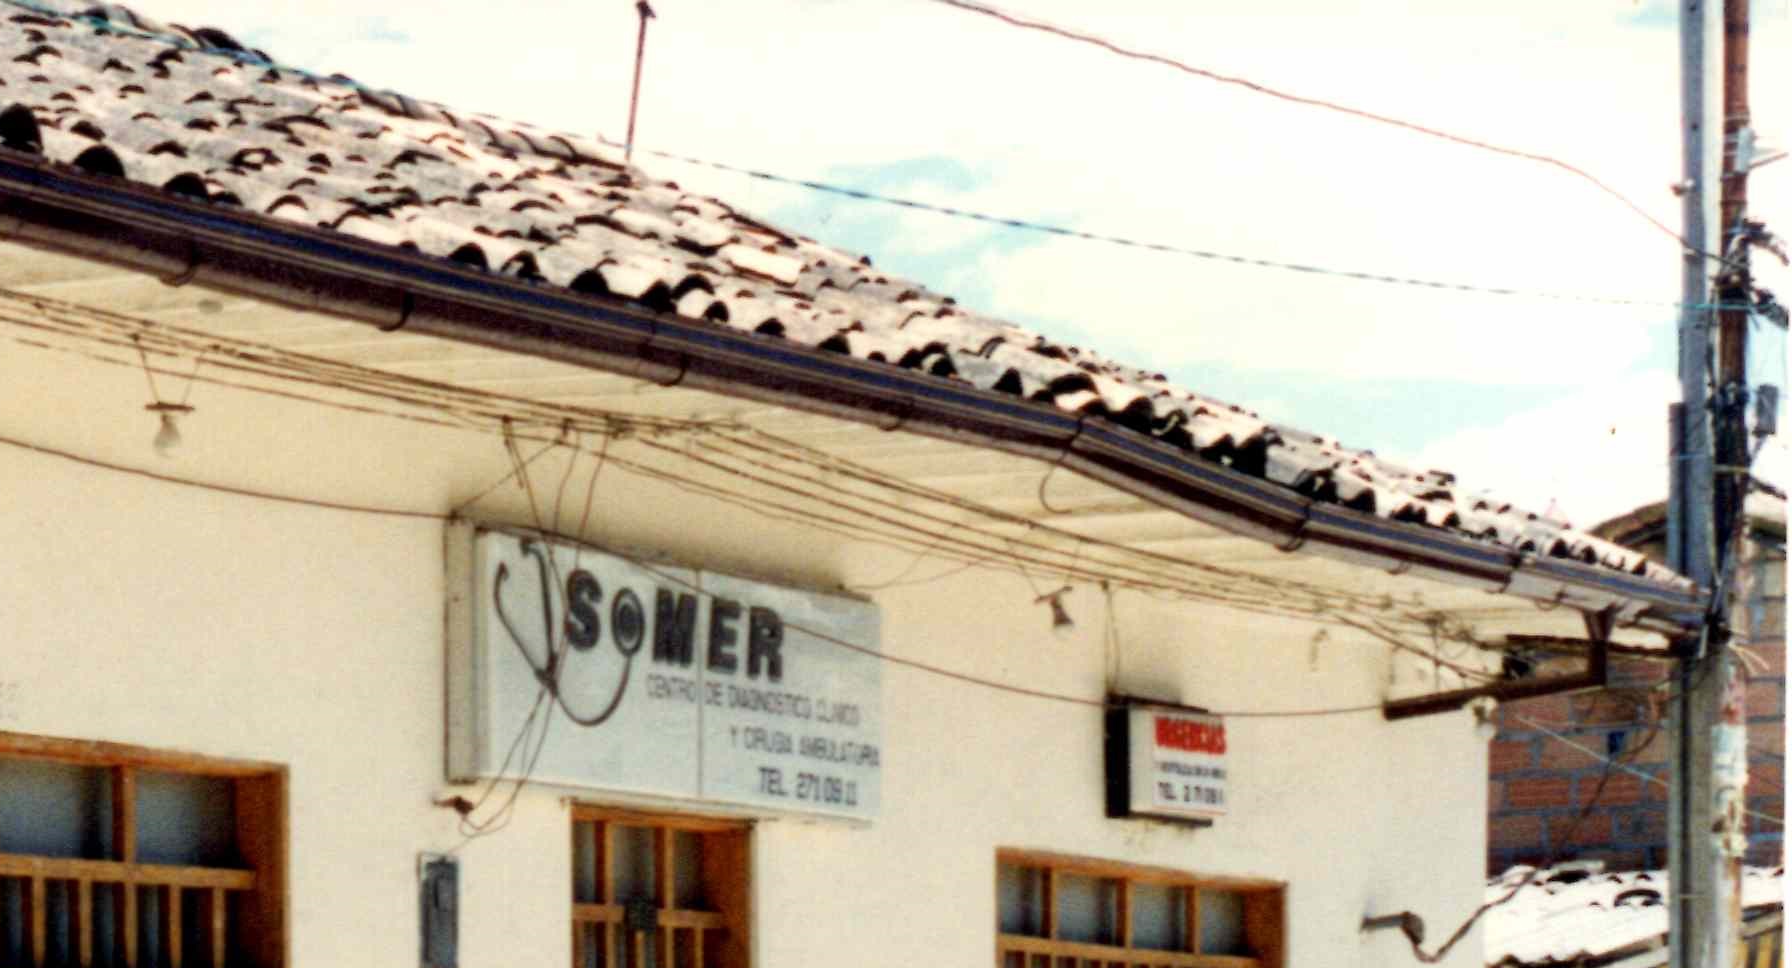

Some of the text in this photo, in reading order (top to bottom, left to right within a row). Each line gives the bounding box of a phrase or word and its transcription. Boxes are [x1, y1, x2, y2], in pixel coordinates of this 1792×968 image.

[565, 568, 784, 683] SOMER
[646, 672, 696, 703] CENTRO
[705, 681, 722, 706] DE
